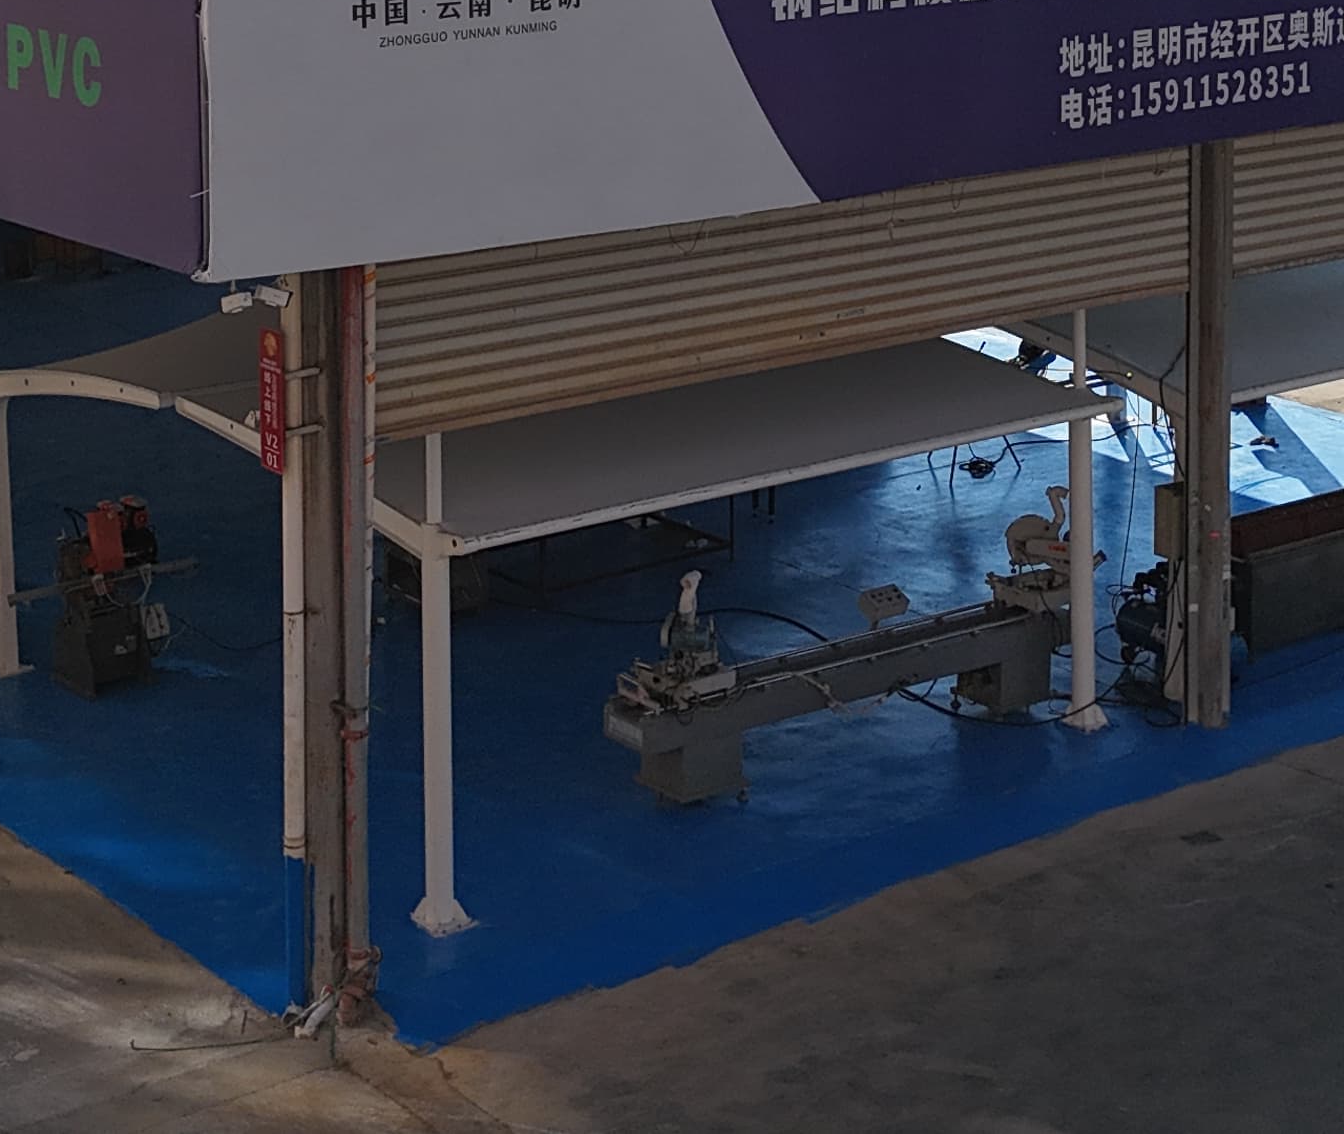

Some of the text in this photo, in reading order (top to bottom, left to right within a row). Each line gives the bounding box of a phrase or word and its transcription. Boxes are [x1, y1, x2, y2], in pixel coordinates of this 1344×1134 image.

[379, 19, 558, 48] ZHONGGUO YUNNAN KUNMING
[5, 22, 103, 108] PVC
